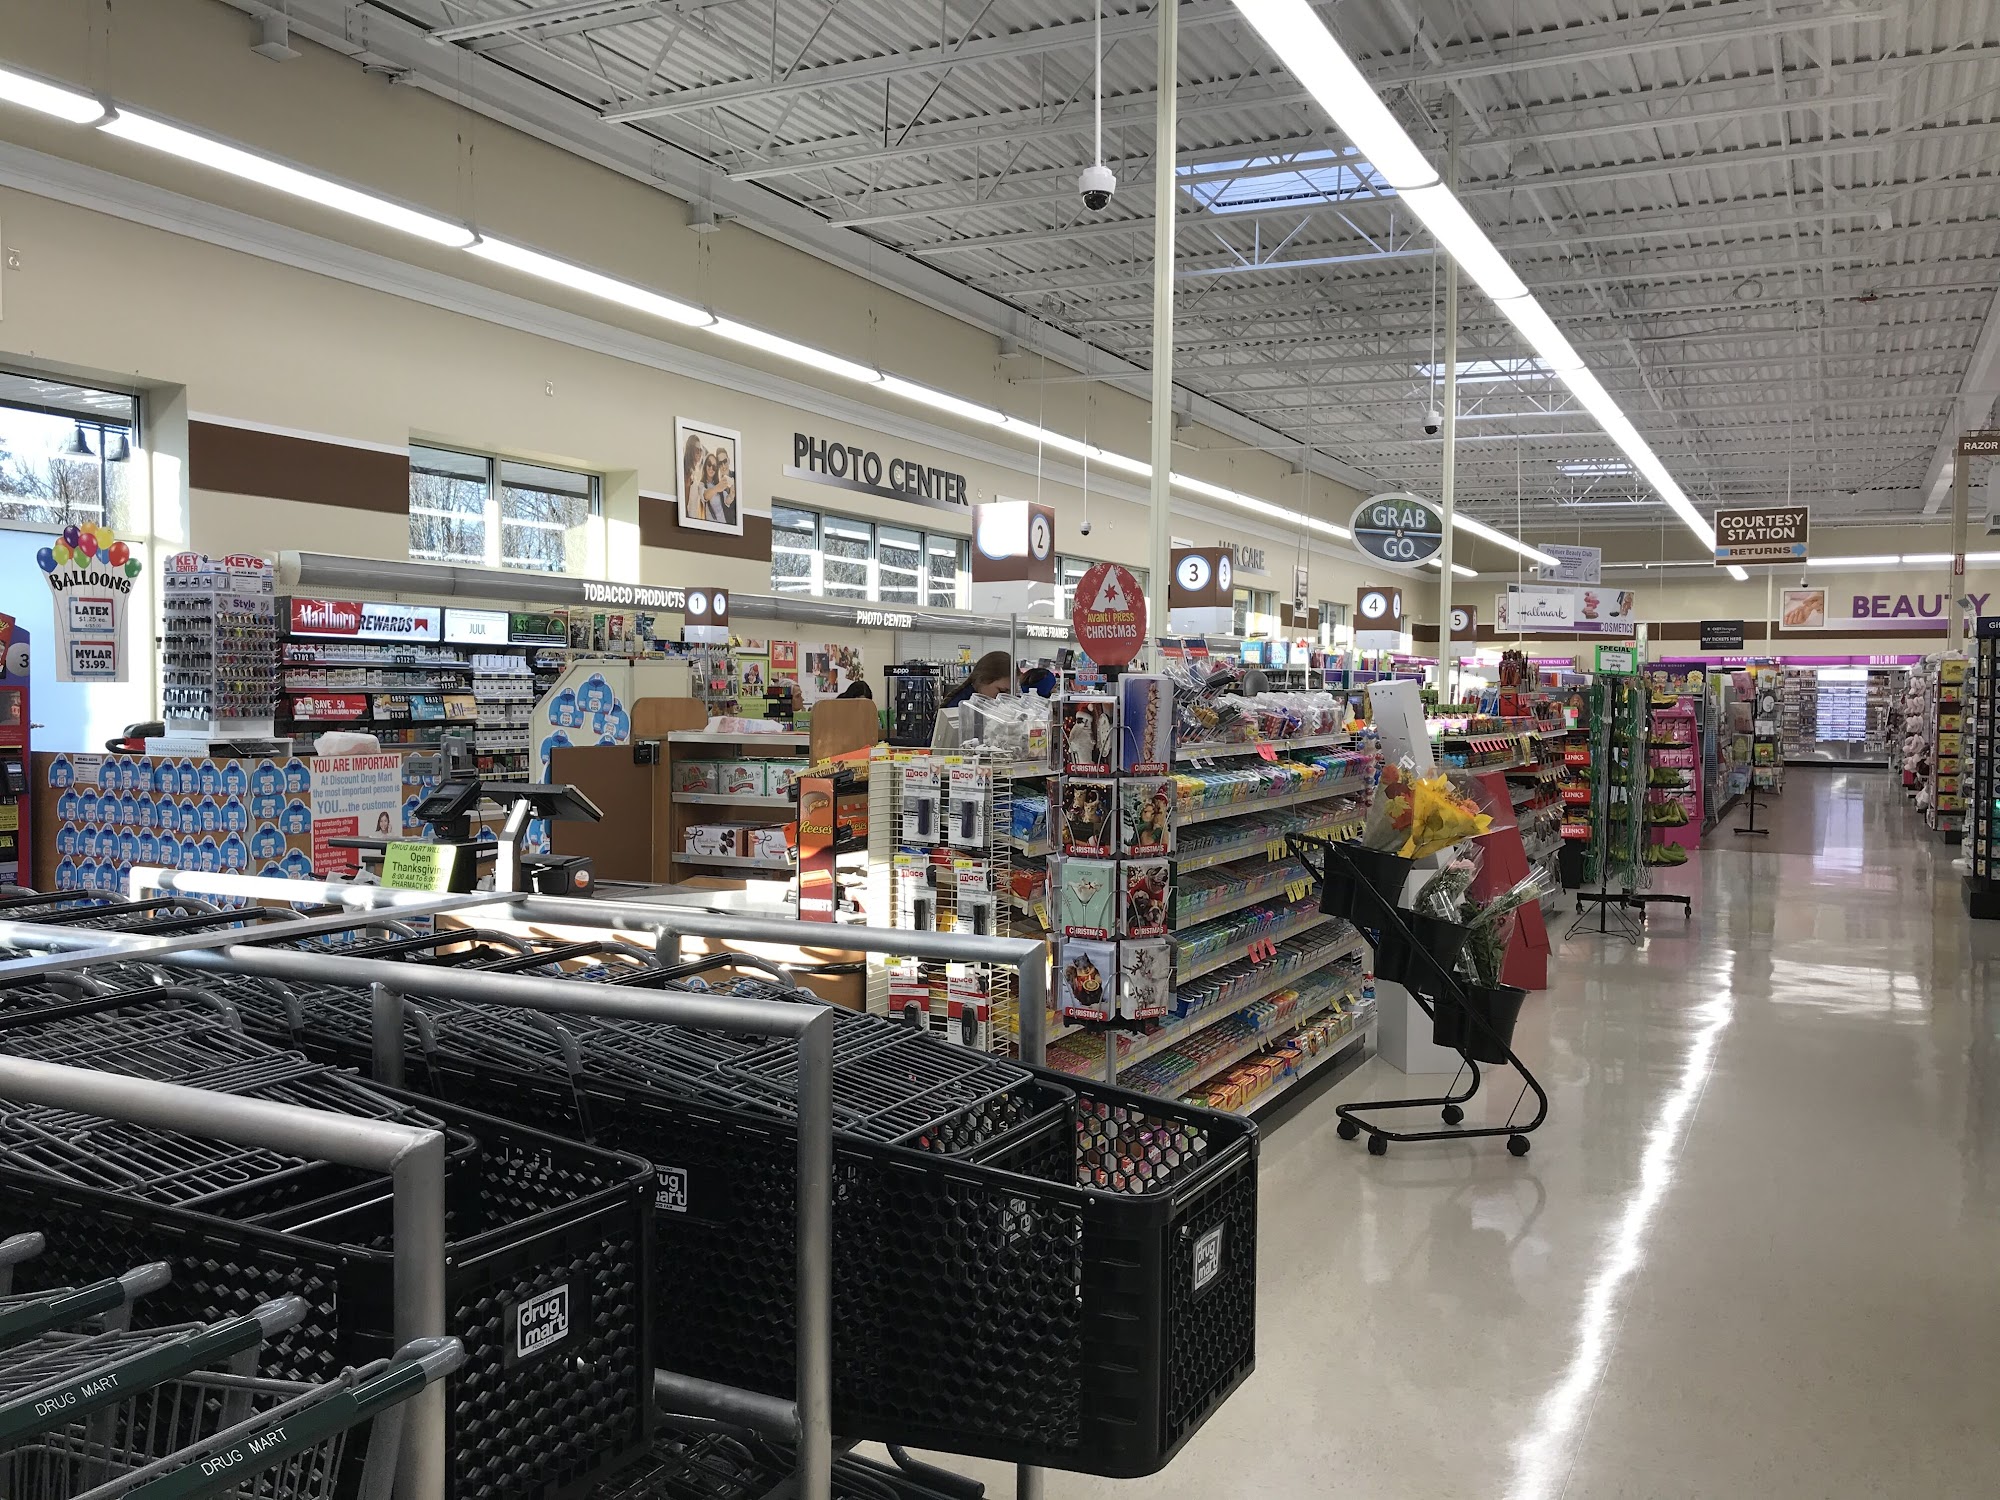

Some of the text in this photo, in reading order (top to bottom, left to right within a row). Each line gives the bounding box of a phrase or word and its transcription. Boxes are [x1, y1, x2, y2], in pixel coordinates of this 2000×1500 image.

[1964, 441, 1998, 450] RAZOR
[794, 432, 969, 506] PHOTO CENTER
[1372, 505, 1426, 528] GRAB
[1720, 514, 1804, 528] COURTESY
[1037, 524, 1043, 549] 2
[1396, 529, 1403, 538] &
[1727, 527, 1795, 541] STATION
[1383, 537, 1414, 558] GO
[1730, 546, 1791, 556] RETURNS
[176, 555, 198, 566] KEY
[224, 556, 263, 570] KEYS
[1241, 546, 1265, 570] CARE
[176, 565, 198, 573] CENTER
[1189, 563, 1199, 582] 3
[1222, 563, 1227, 582] 3
[49, 570, 131, 594] BALLOONS
[582, 583, 685, 609] TOBACCO PRODUCTS
[233, 598, 256, 609] Style
[695, 597, 699, 610] 1
[717, 597, 721, 610] 1
[1369, 598, 1378, 612] 4
[1852, 593, 1991, 618] BEAUY
[75, 606, 109, 616] LATEX
[300, 602, 413, 633] Marlboro REWARDS
[1517, 604, 1567, 622] Hallmark
[856, 610, 912, 628] PHOTO CENTER
[1454, 614, 1461, 626] 5
[1026, 624, 1069, 639] PICTURE FRAMES
[1600, 622, 1633, 633] COSMETICS
[75, 649, 112, 659] MYLAR
[1598, 645, 1631, 653] SPECIAL
[20, 653, 29, 669] 3
[79, 659, 106, 669] $3.99
[1869, 655, 1898, 665] MILANI
[314, 699, 332, 709] SAVE
[1564, 753, 1584, 761] LINKS
[313, 756, 399, 774] YOU ARE IMPORTANT
[1071, 764, 1105, 773] CHRISTMAS
[1134, 764, 1164, 772] CHRISTMAS
[321, 772, 393, 786] At Discount Drug Mart
[905, 768, 928, 778] mace
[952, 770, 974, 780] mace
[313, 784, 400, 798] the most important person is
[361, 801, 397, 811] customer.
[799, 820, 833, 835] Reese's
[391, 843, 409, 851] DRUG
[1070, 846, 1104, 855] CHRISTMAS
[1134, 845, 1164, 854] CHRISTMAS
[410, 852, 431, 864] Open
[901, 869, 924, 878] mace
[960, 873, 984, 882] mace
[391, 880, 439, 891] PHARMACY HOUR
[1069, 927, 1103, 937] CHRISTMAS
[1134, 926, 1163, 936] CHRISTMAS
[1069, 1009, 1103, 1020] CHRISTMAS
[1135, 1007, 1165, 1017] CHRISTMAS
[657, 1173, 679, 1193] ug
[1198, 1240, 1216, 1264] drug
[1199, 1254, 1218, 1280] mart
[521, 1297, 560, 1327] drug
[525, 1312, 565, 1347] mart
[34, 1373, 119, 1417] DRUG MART
[200, 1427, 287, 1476] DRUG MART
